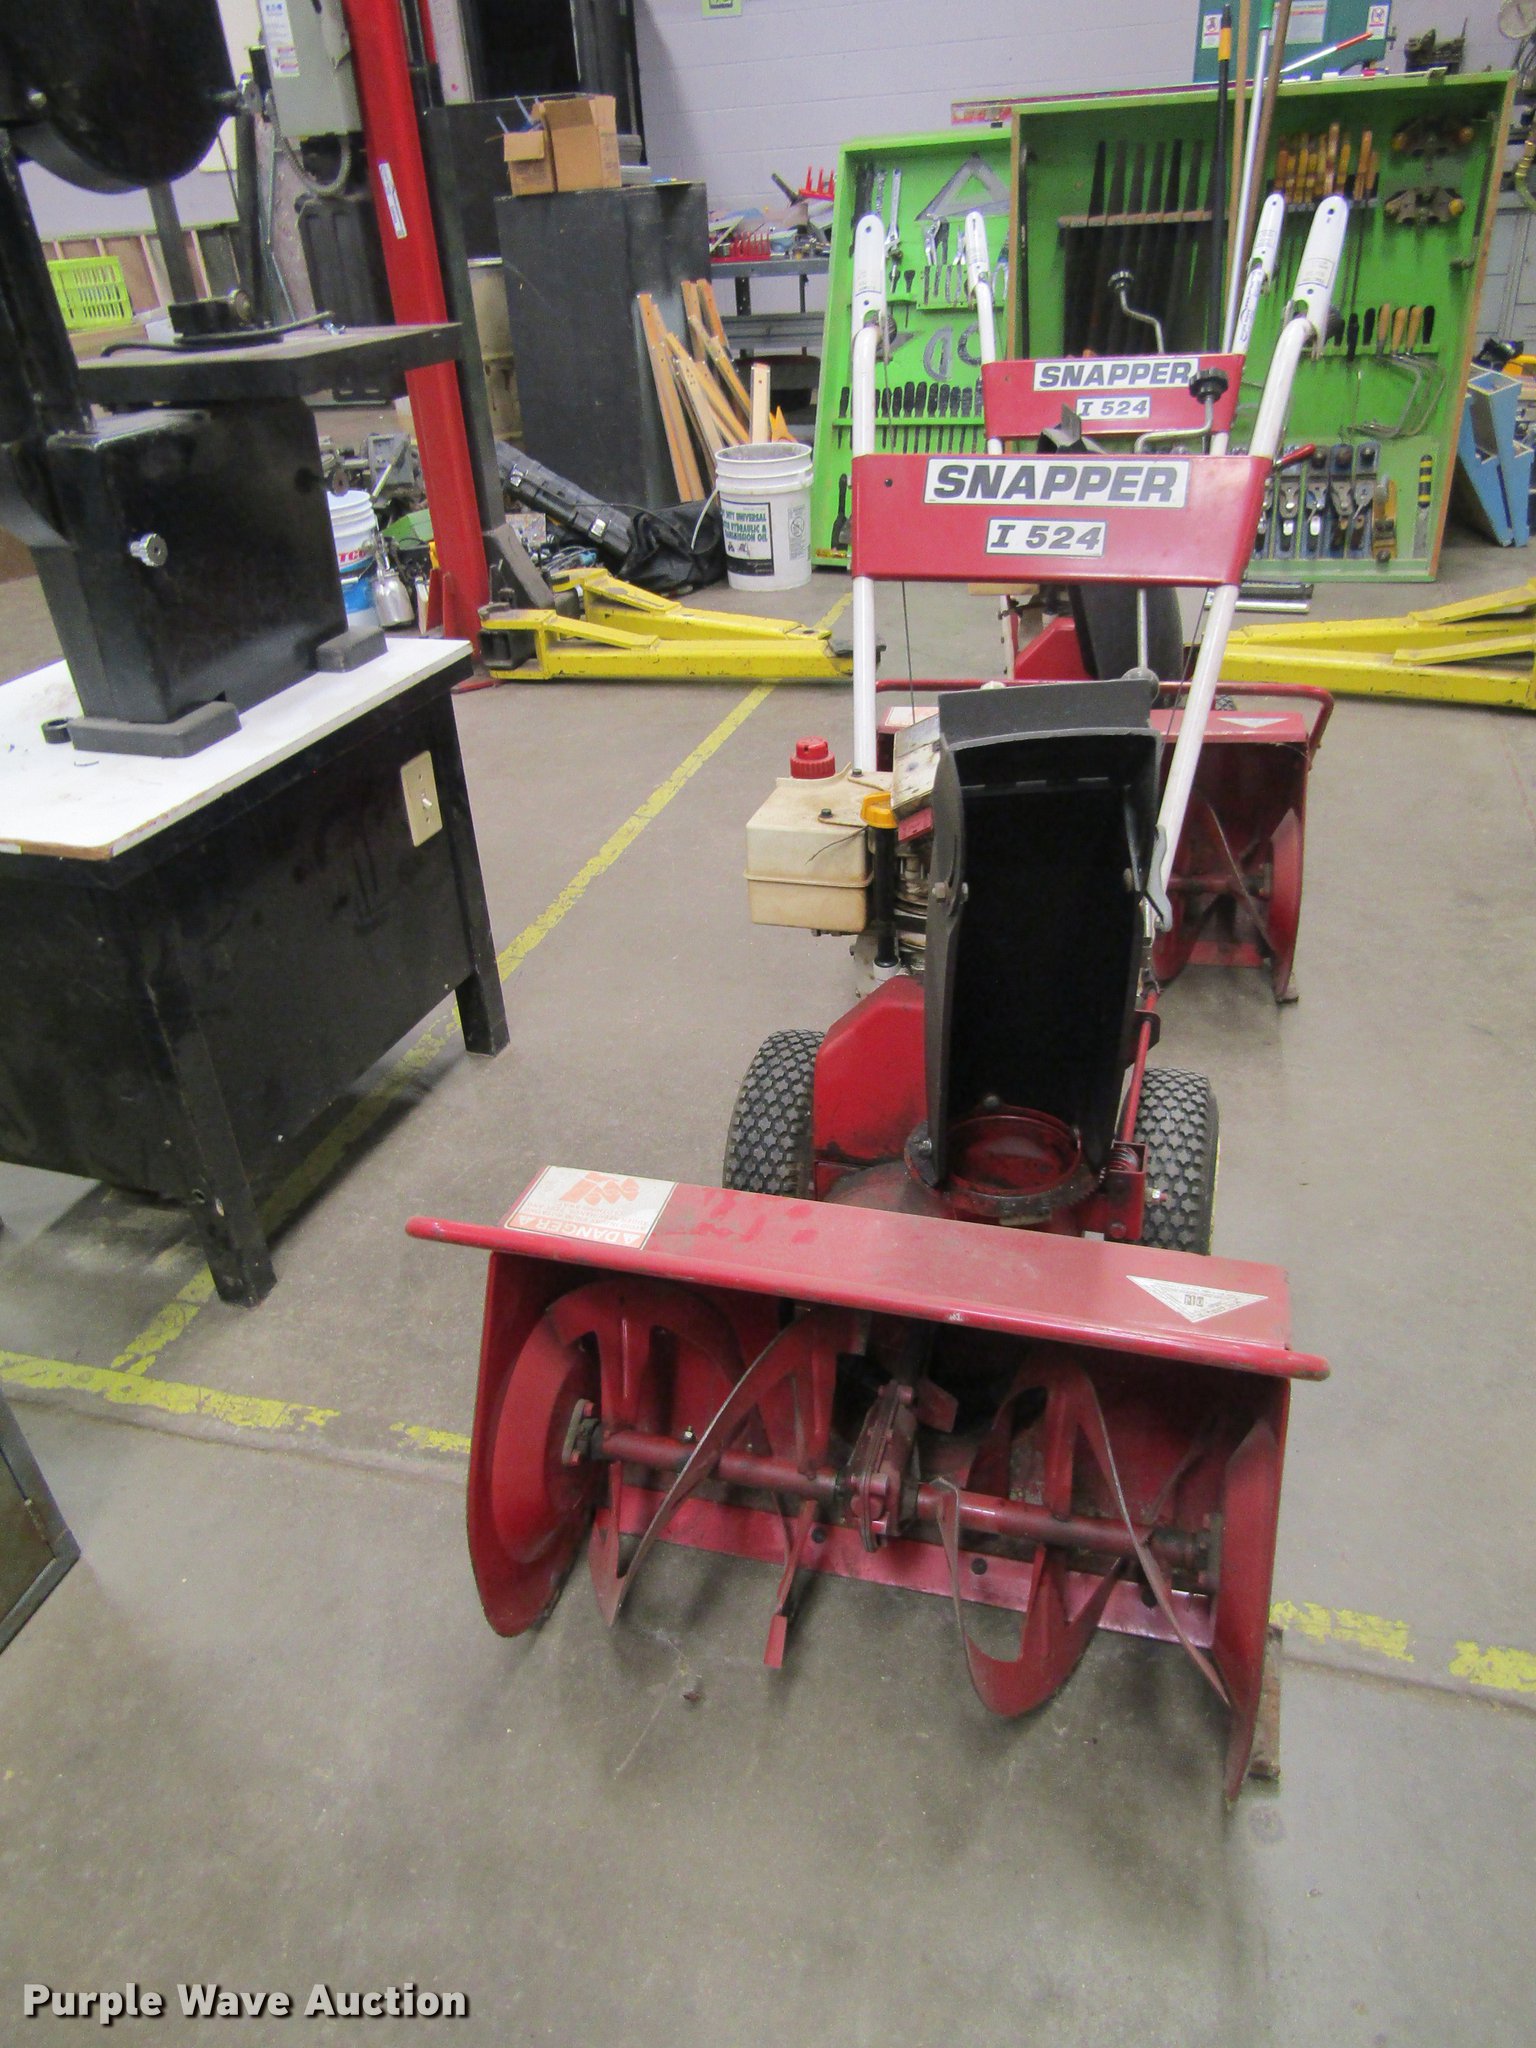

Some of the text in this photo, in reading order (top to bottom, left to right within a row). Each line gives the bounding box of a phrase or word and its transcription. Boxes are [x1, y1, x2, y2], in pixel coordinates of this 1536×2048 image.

[1039, 361, 1192, 388] SNAPPER
[1100, 400, 1149, 416] 524
[933, 464, 1178, 503] SNAPPER
[990, 523, 1103, 550] I 524
[535, 1218, 621, 1242] DANGER
